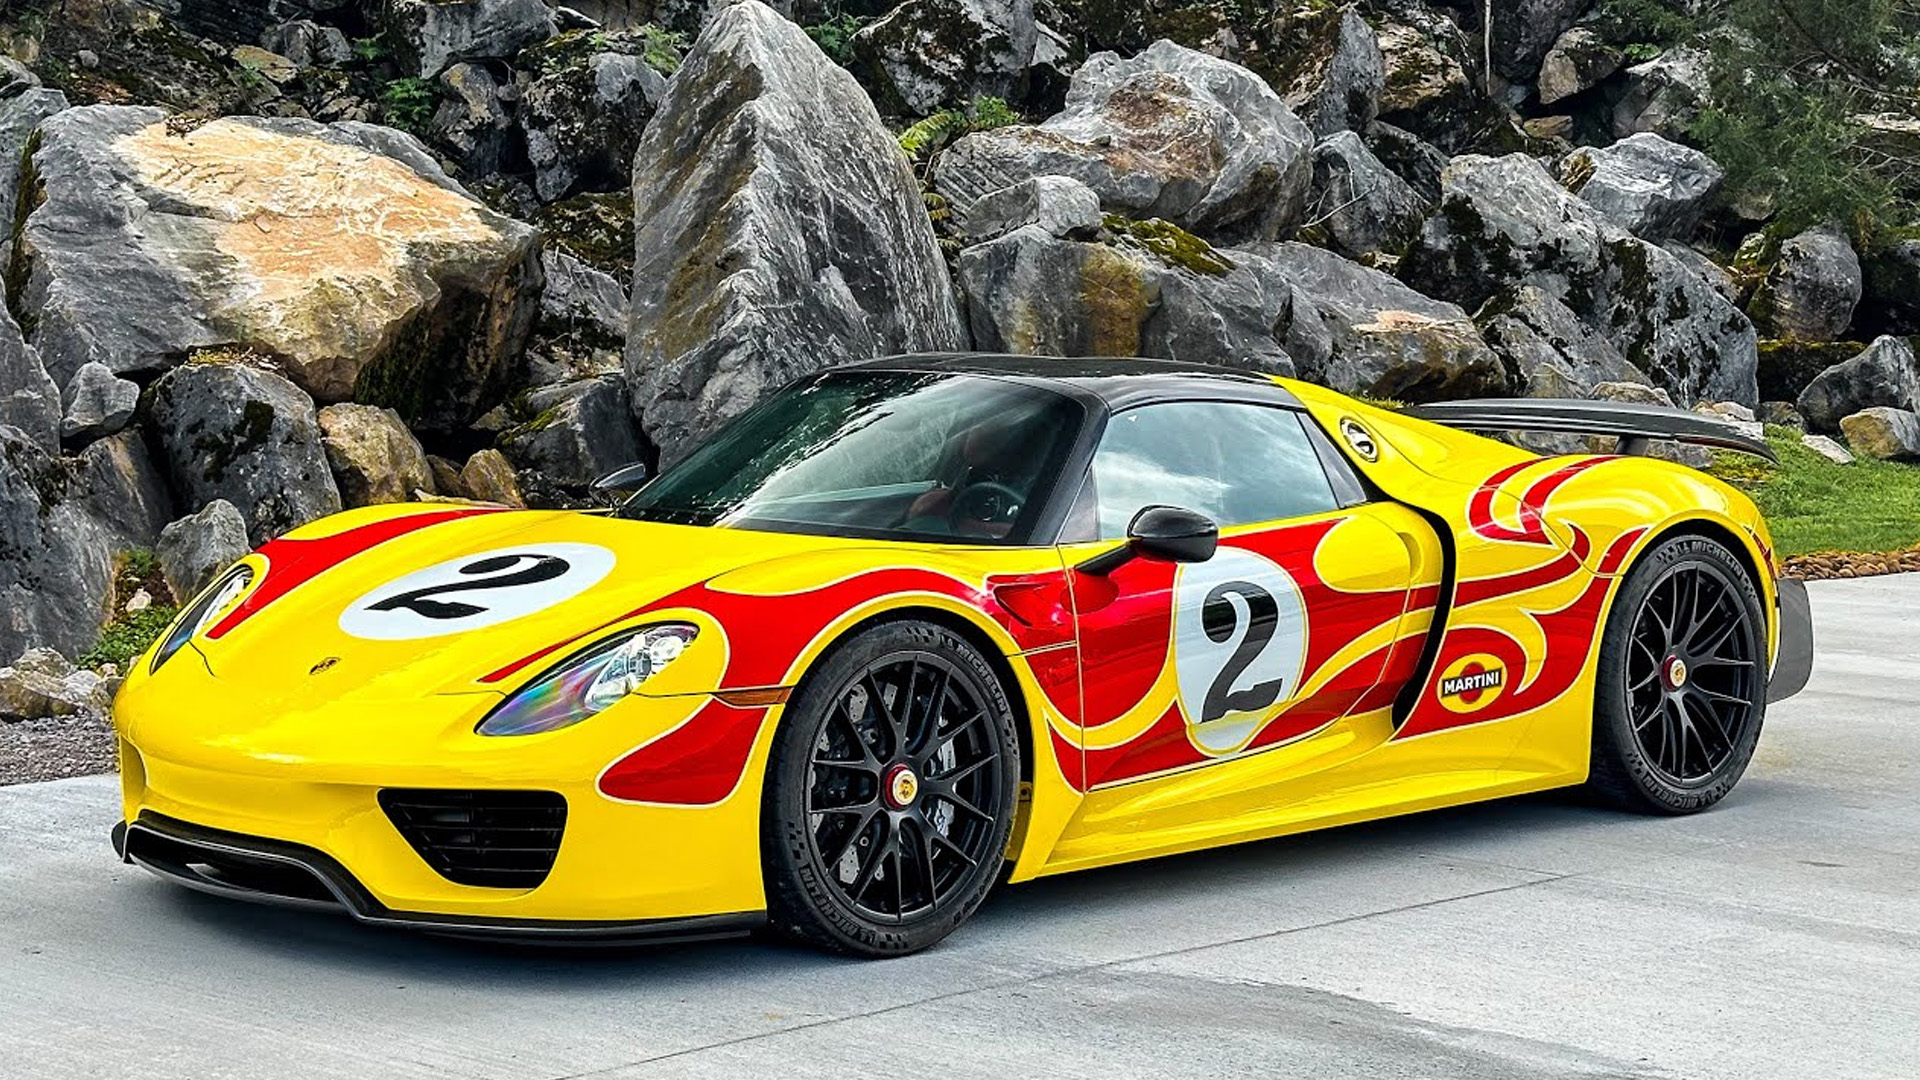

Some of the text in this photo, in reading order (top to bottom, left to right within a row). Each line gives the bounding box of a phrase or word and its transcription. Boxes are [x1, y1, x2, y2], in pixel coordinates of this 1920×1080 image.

[363, 554, 570, 620] 2
[1691, 541, 1744, 577] MICHELIN
[956, 644, 1007, 712] MICHELIN
[1202, 580, 1284, 723] 2
[1444, 671, 1499, 695] MARTINI
[1641, 771, 1699, 809] MICHELIN
[800, 867, 860, 936] MICHELIN
